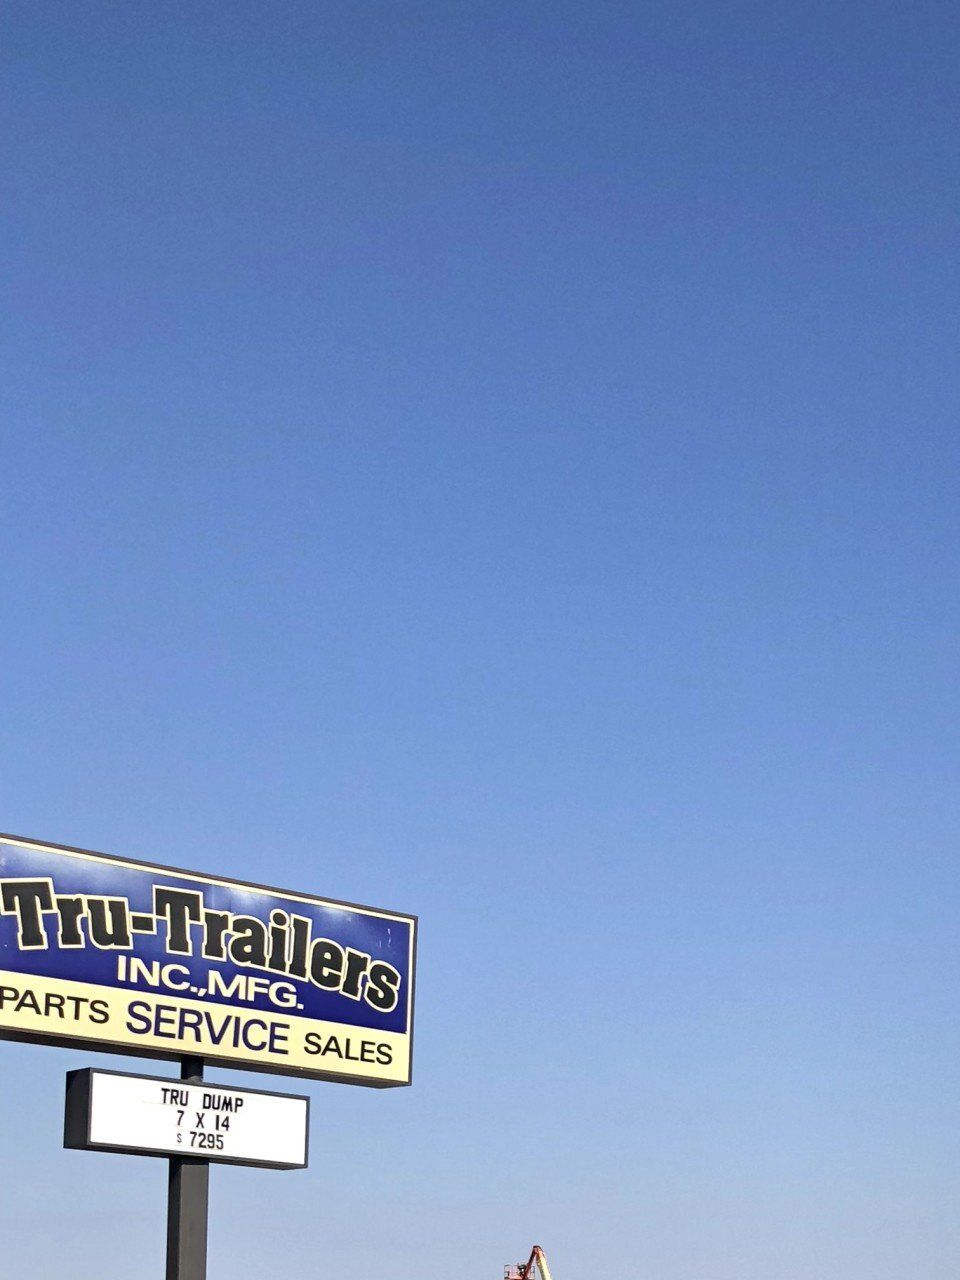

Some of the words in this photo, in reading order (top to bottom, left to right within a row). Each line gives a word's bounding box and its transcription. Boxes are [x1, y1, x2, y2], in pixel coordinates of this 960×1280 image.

[0, 877, 402, 1012] Tru-Trailers
[0, 985, 110, 1024] PARTS
[126, 1001, 290, 1055] SERVICE
[304, 1032, 393, 1066] SALES
[161, 1087, 189, 1107] TRU
[202, 1093, 244, 1113] DUMP
[177, 1110, 185, 1126] 7
[195, 1112, 205, 1129] X
[215, 1114, 230, 1131] 14
[189, 1131, 225, 1150] 7295
